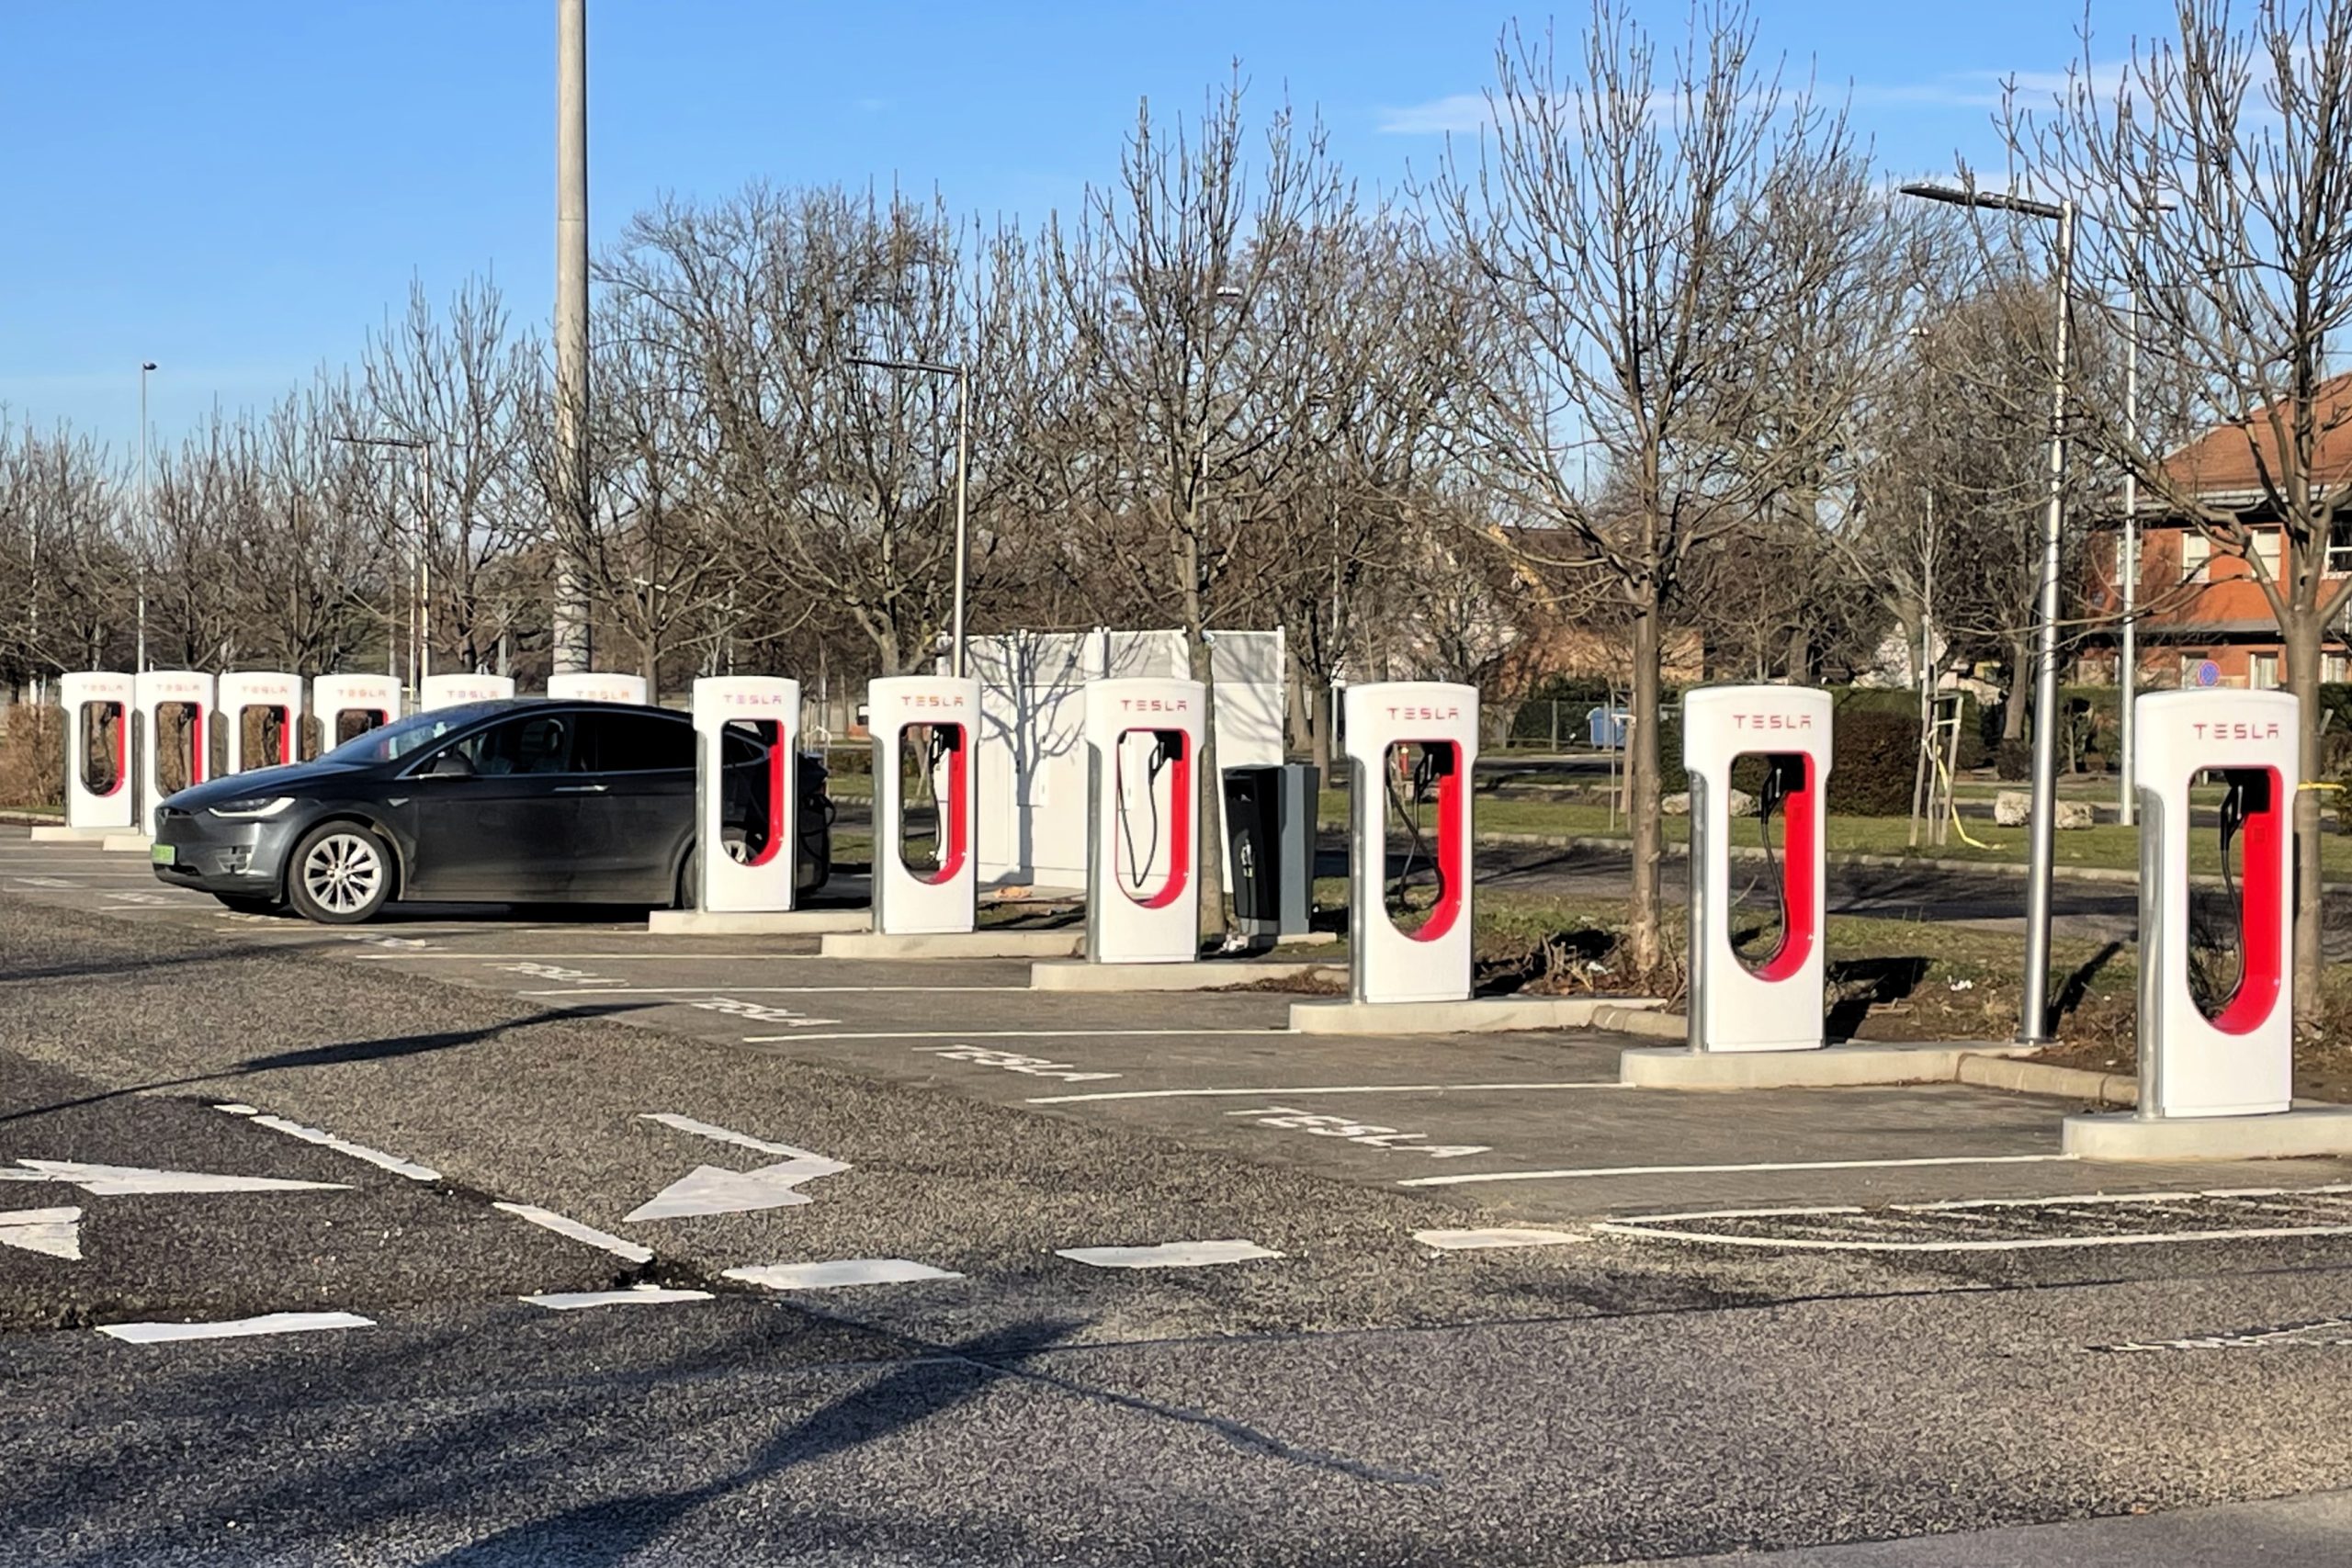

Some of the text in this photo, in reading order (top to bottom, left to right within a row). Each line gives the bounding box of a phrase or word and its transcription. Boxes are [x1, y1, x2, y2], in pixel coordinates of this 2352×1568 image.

[723, 694, 782, 705] TESLA
[901, 695, 964, 706] TESLA
[1121, 699, 1187, 711] TESLA
[1386, 706, 1458, 720] TESLA
[1733, 714, 1811, 728] TESLA
[2192, 722, 2278, 739] TESLA
